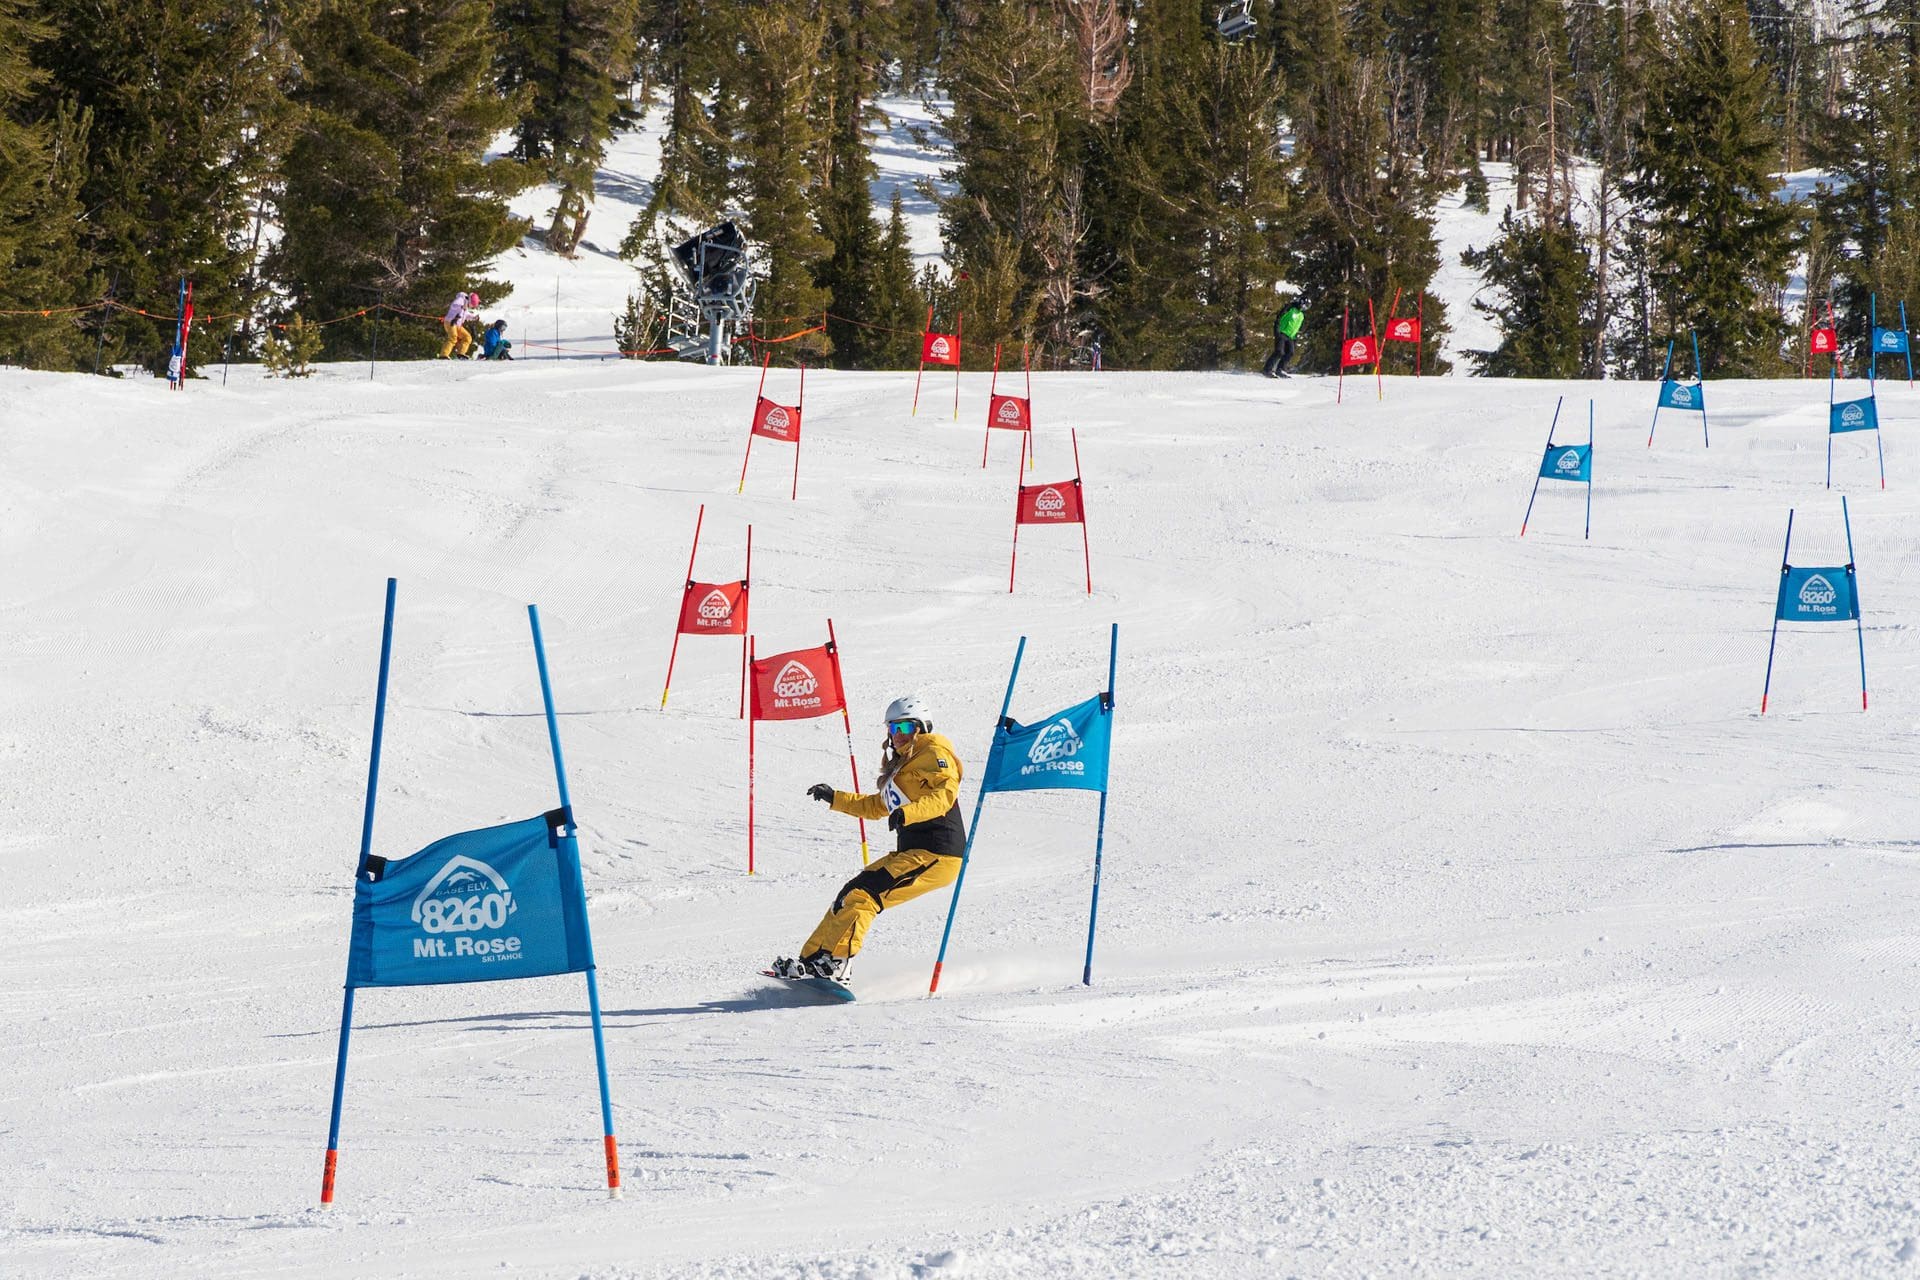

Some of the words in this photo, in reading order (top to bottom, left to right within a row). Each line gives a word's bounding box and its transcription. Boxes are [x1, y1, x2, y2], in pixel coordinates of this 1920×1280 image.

[774, 698, 792, 708] Mt.
[792, 696, 820, 706] Rose
[1021, 764, 1044, 776] Mt.
[1046, 761, 1084, 770] Rose
[467, 881, 489, 892] ELV.
[413, 938, 453, 958] Mt.
[454, 936, 522, 956] Rose
[497, 952, 524, 962] TAHOE
